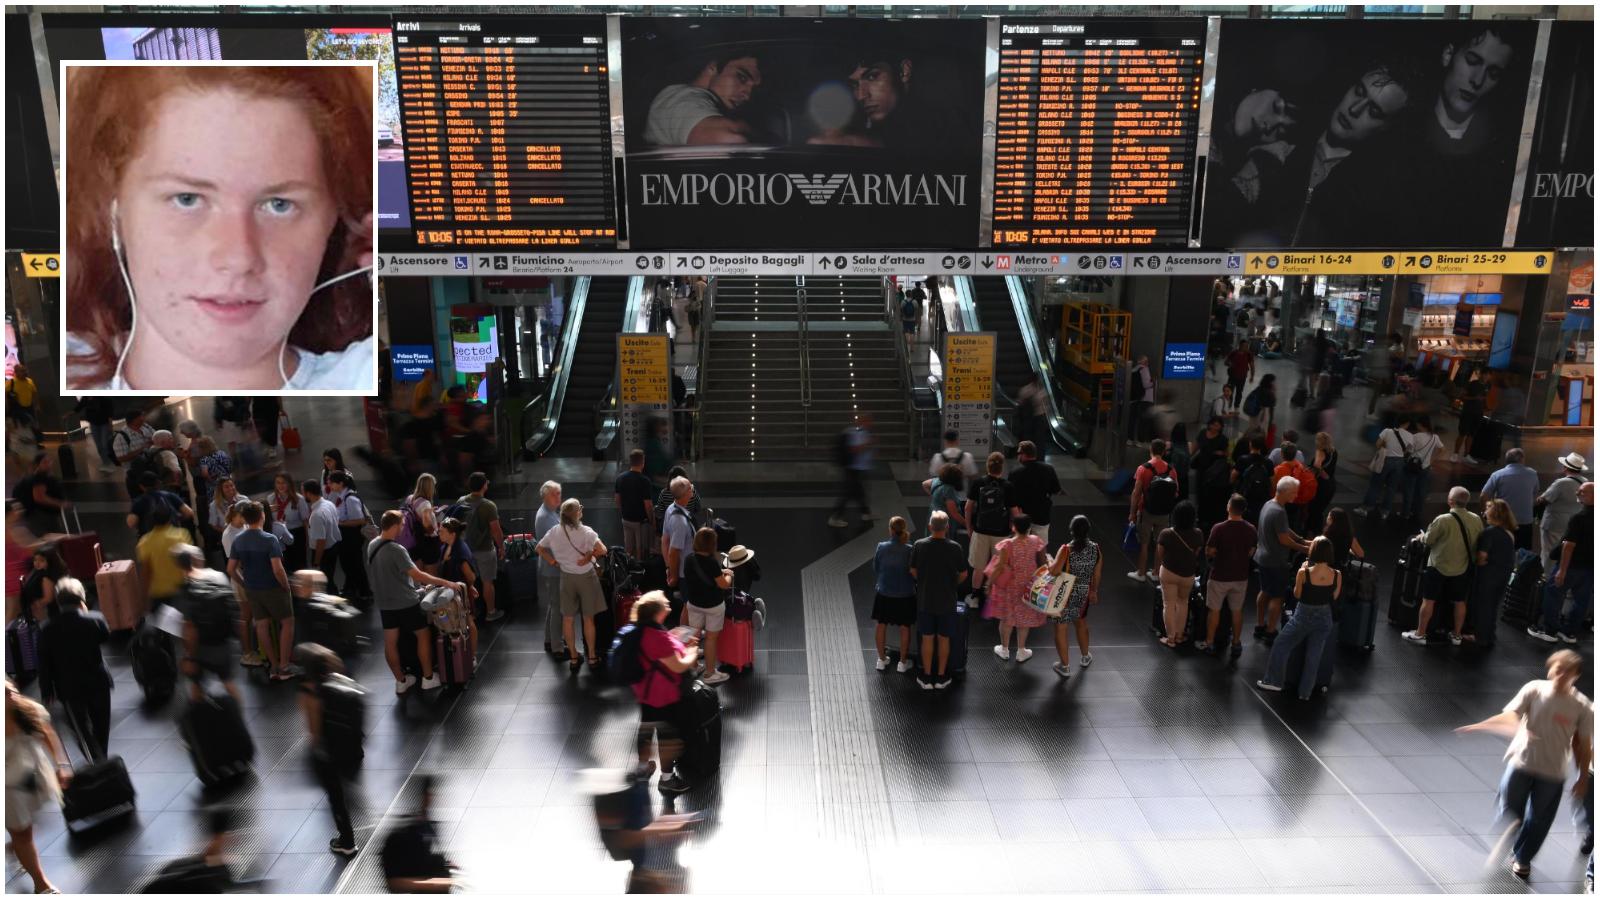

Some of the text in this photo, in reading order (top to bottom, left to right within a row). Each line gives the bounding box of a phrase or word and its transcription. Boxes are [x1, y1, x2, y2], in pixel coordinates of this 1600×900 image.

[396, 22, 481, 32] Arrivi Arrivals
[1002, 24, 1085, 34] Partenze Departures
[640, 172, 793, 206] EMPORIO
[838, 172, 967, 206] ARMANI
[428, 231, 452, 243] 10:05
[1005, 231, 1028, 242] 10:05
[390, 256, 448, 266] Ascensore
[512, 256, 564, 266] Fiumicino
[709, 256, 805, 268] Deposito Bagagli
[852, 256, 926, 266] Sala d'attesa
[997, 256, 1010, 268] M
[1014, 256, 1048, 266] Metro
[1166, 256, 1222, 266] Ascensore
[1284, 255, 1352, 264] Binari 16-24
[1437, 254, 1506, 264] Binari 25-29
[723, 266, 748, 274] Luggage
[852, 266, 876, 274] Waiting
[624, 338, 650, 346] Uscite
[952, 338, 977, 346] Uscite
